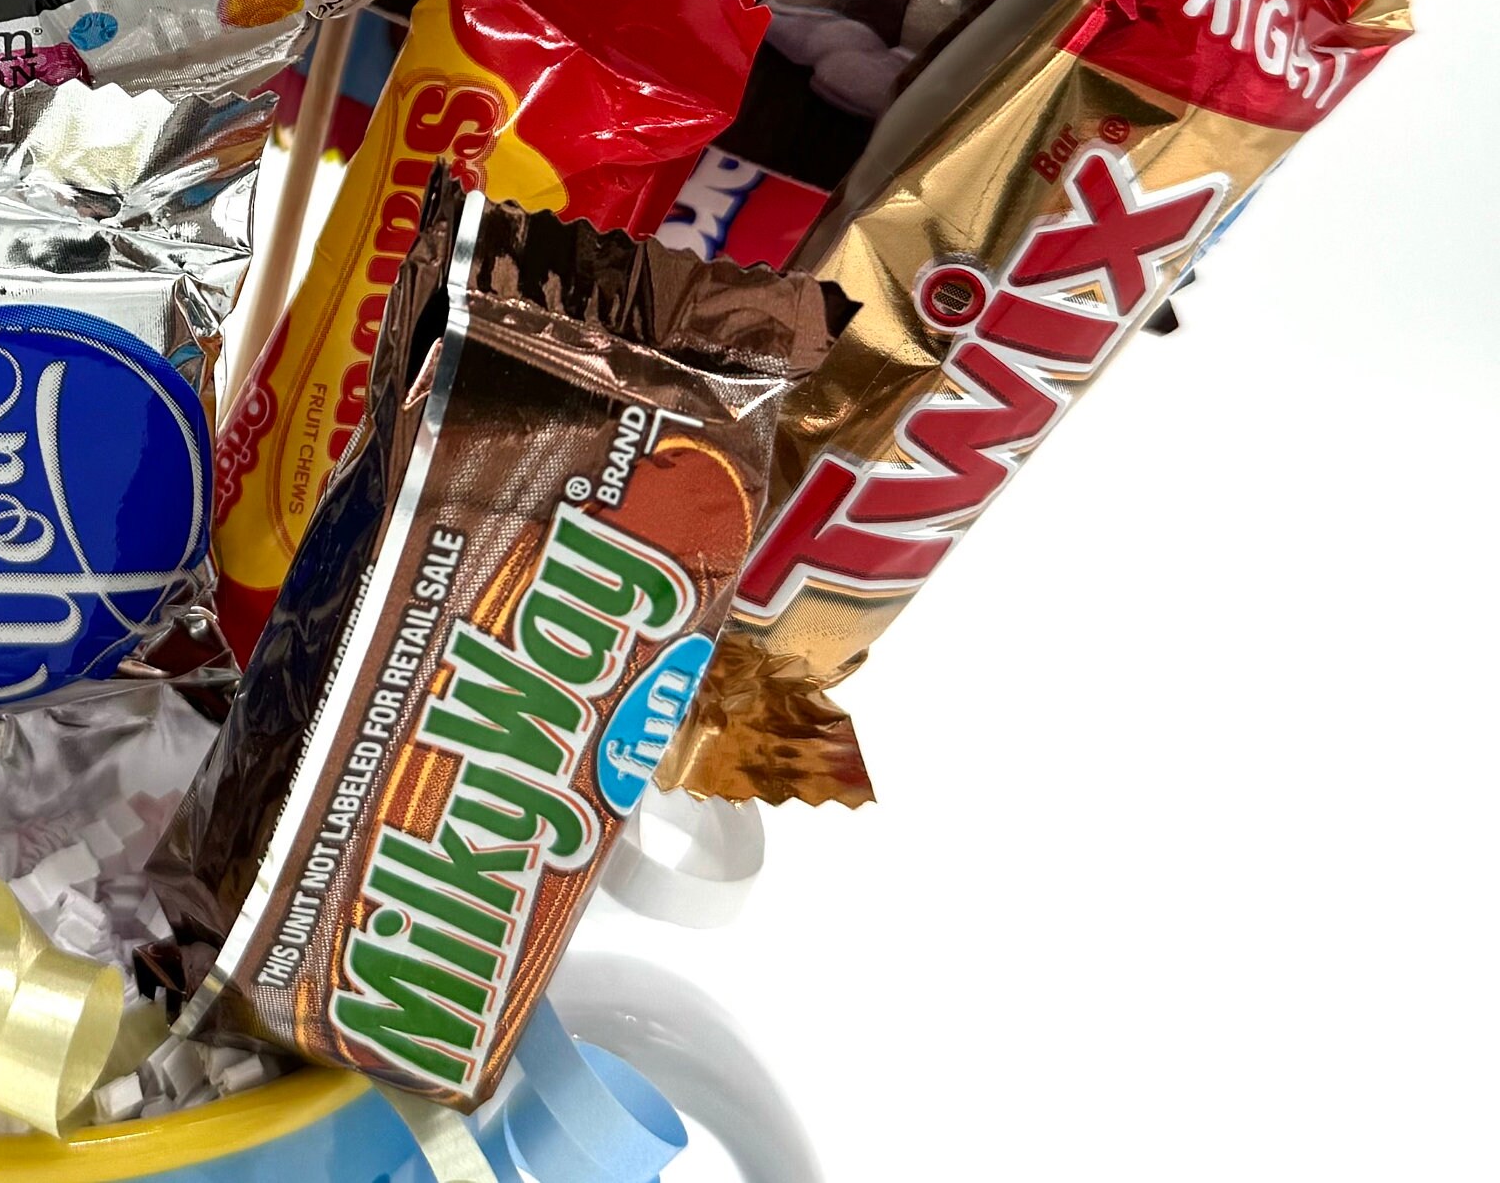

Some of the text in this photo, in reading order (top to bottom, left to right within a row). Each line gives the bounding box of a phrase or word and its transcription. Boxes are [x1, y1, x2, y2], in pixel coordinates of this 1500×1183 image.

[1028, 121, 1089, 184] Bar
[285, 381, 329, 515] FRUIT CHEWS
[598, 405, 648, 507] BRAND
[257, 944, 296, 988] THIS
[277, 890, 318, 946] UNIT
[304, 841, 340, 891] NOT
[322, 742, 382, 839] LABELED
[363, 693, 401, 743] FOR
[382, 605, 439, 690] RETAIL
[416, 529, 464, 601] SALE
